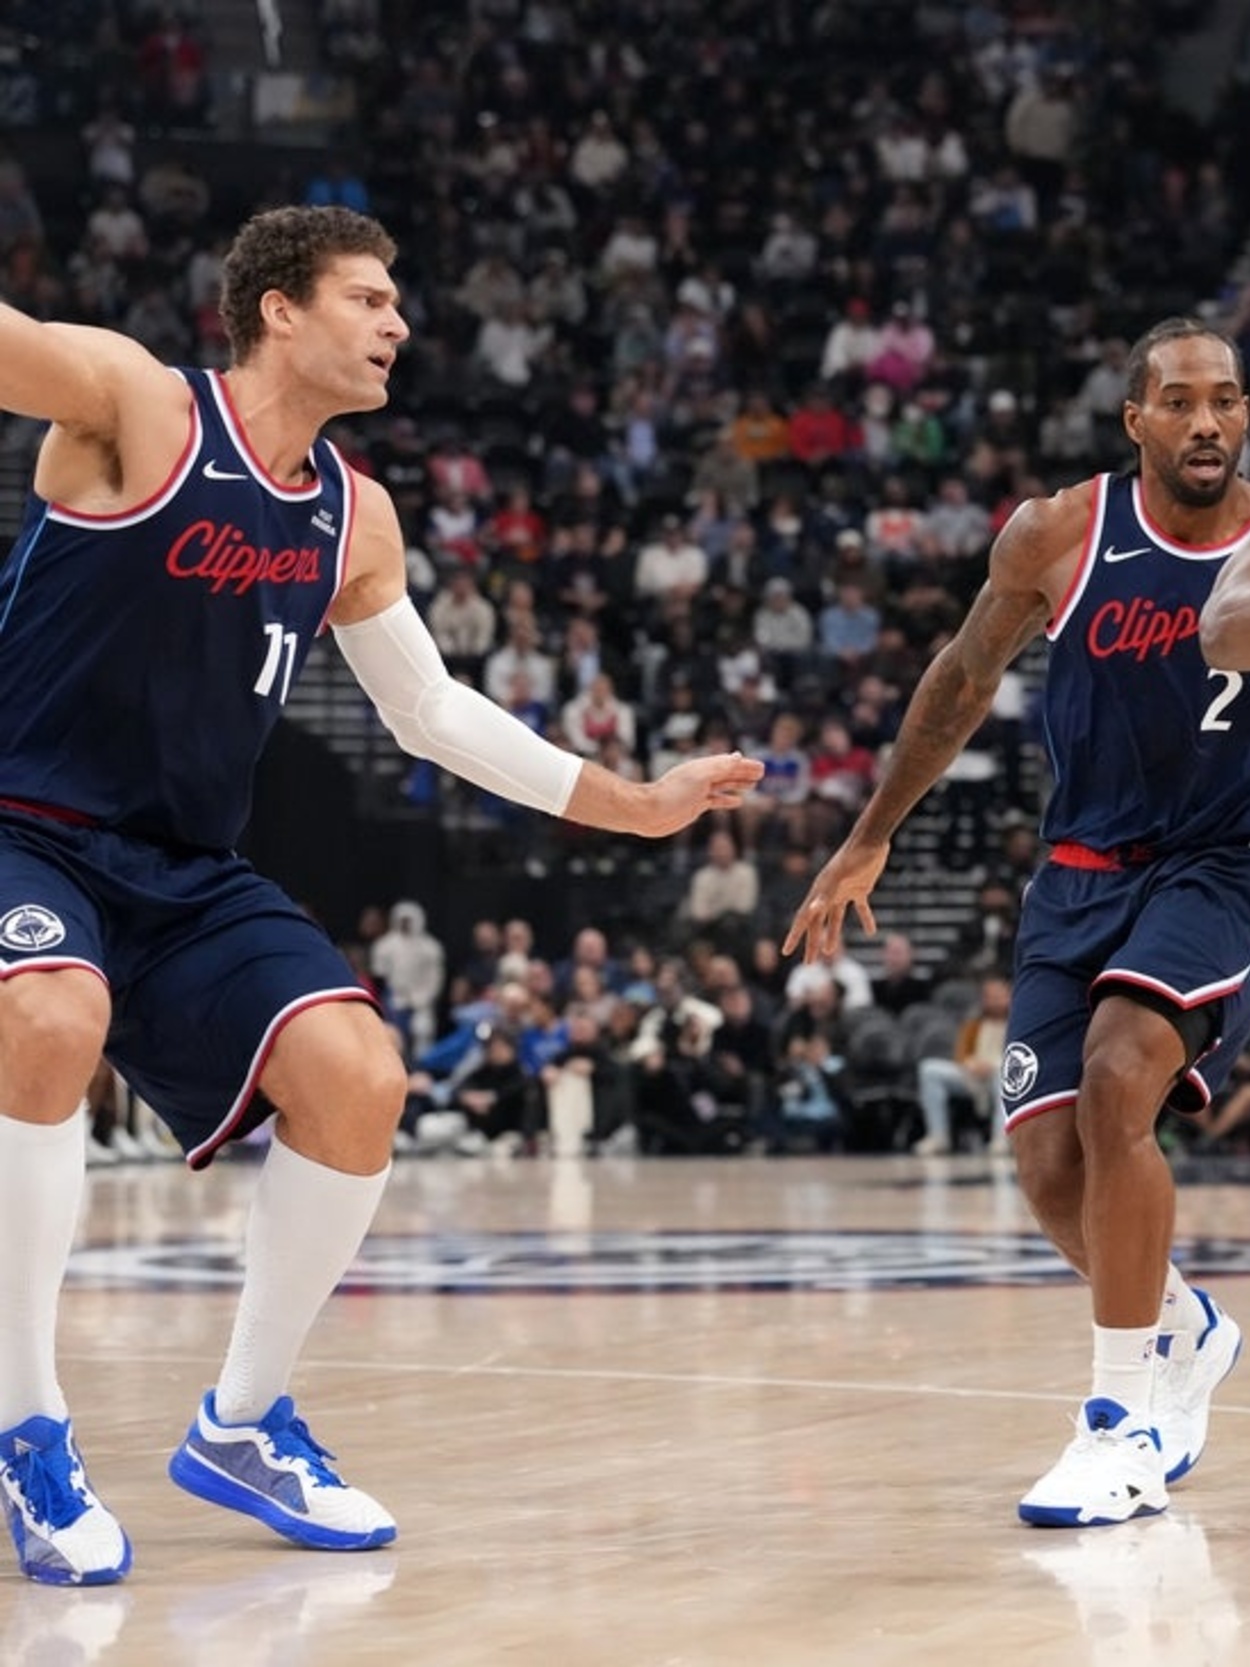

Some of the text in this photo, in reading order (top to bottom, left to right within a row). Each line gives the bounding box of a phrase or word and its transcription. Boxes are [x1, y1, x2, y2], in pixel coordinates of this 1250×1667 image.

[166, 521, 320, 594] Clippers
[253, 622, 298, 706] 11
[1087, 597, 1201, 662] Clipp
[1200, 668, 1244, 731] 2
